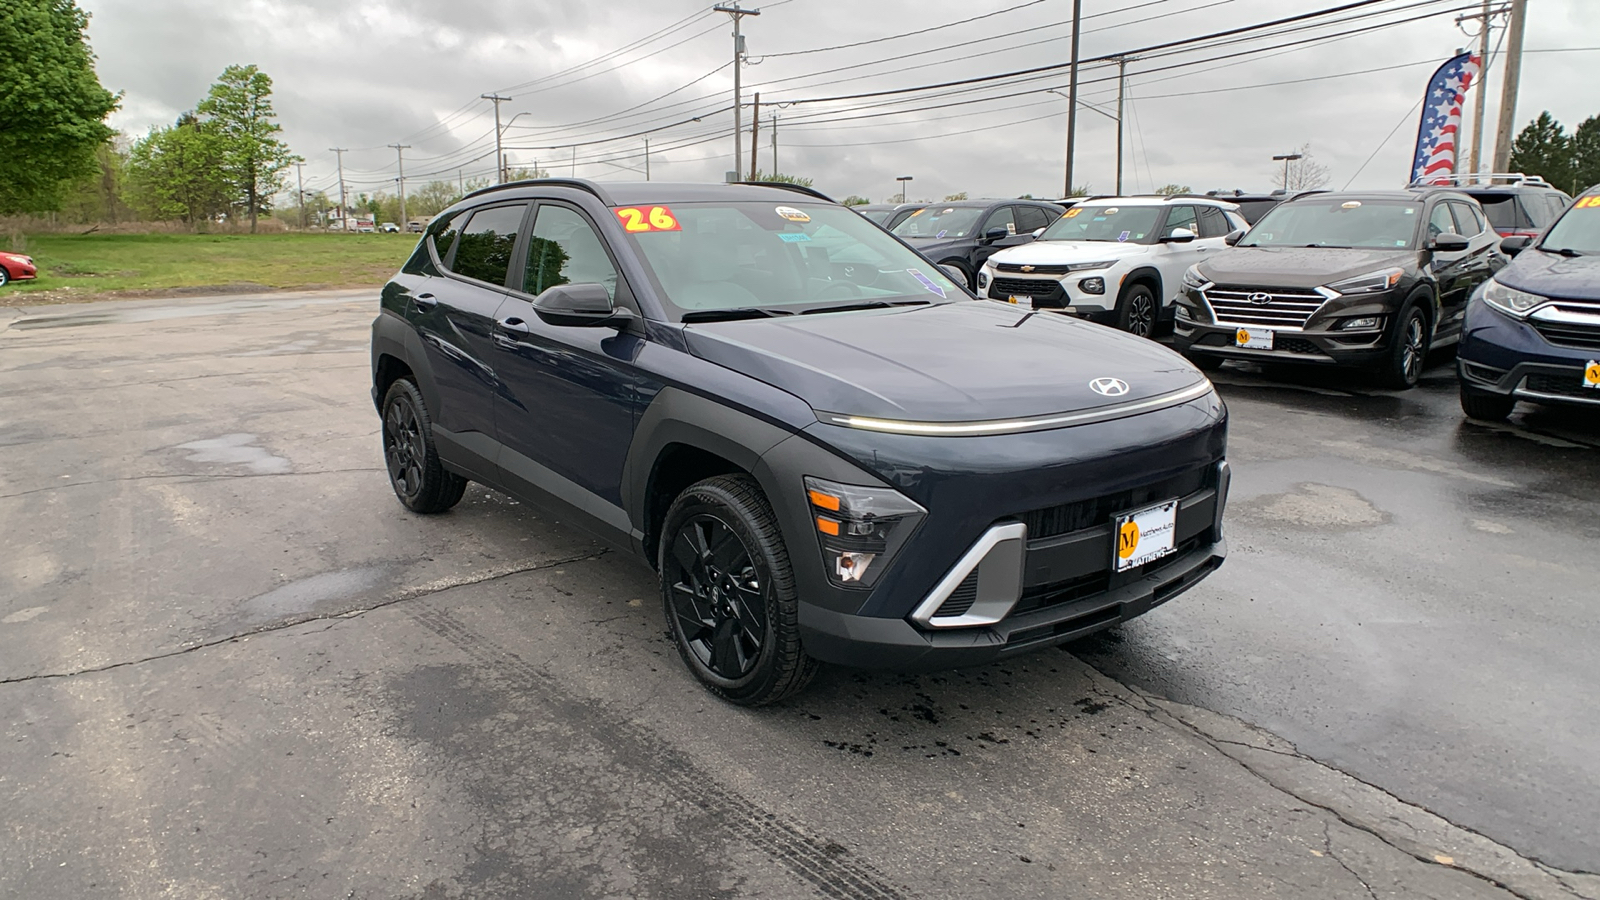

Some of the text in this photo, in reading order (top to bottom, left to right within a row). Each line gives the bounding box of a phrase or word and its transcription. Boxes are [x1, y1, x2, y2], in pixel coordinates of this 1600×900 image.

[618, 206, 676, 232] 26
[1240, 333, 1248, 341] M
[1120, 530, 1135, 551] M
[1131, 550, 1165, 568] MATTHEWS
